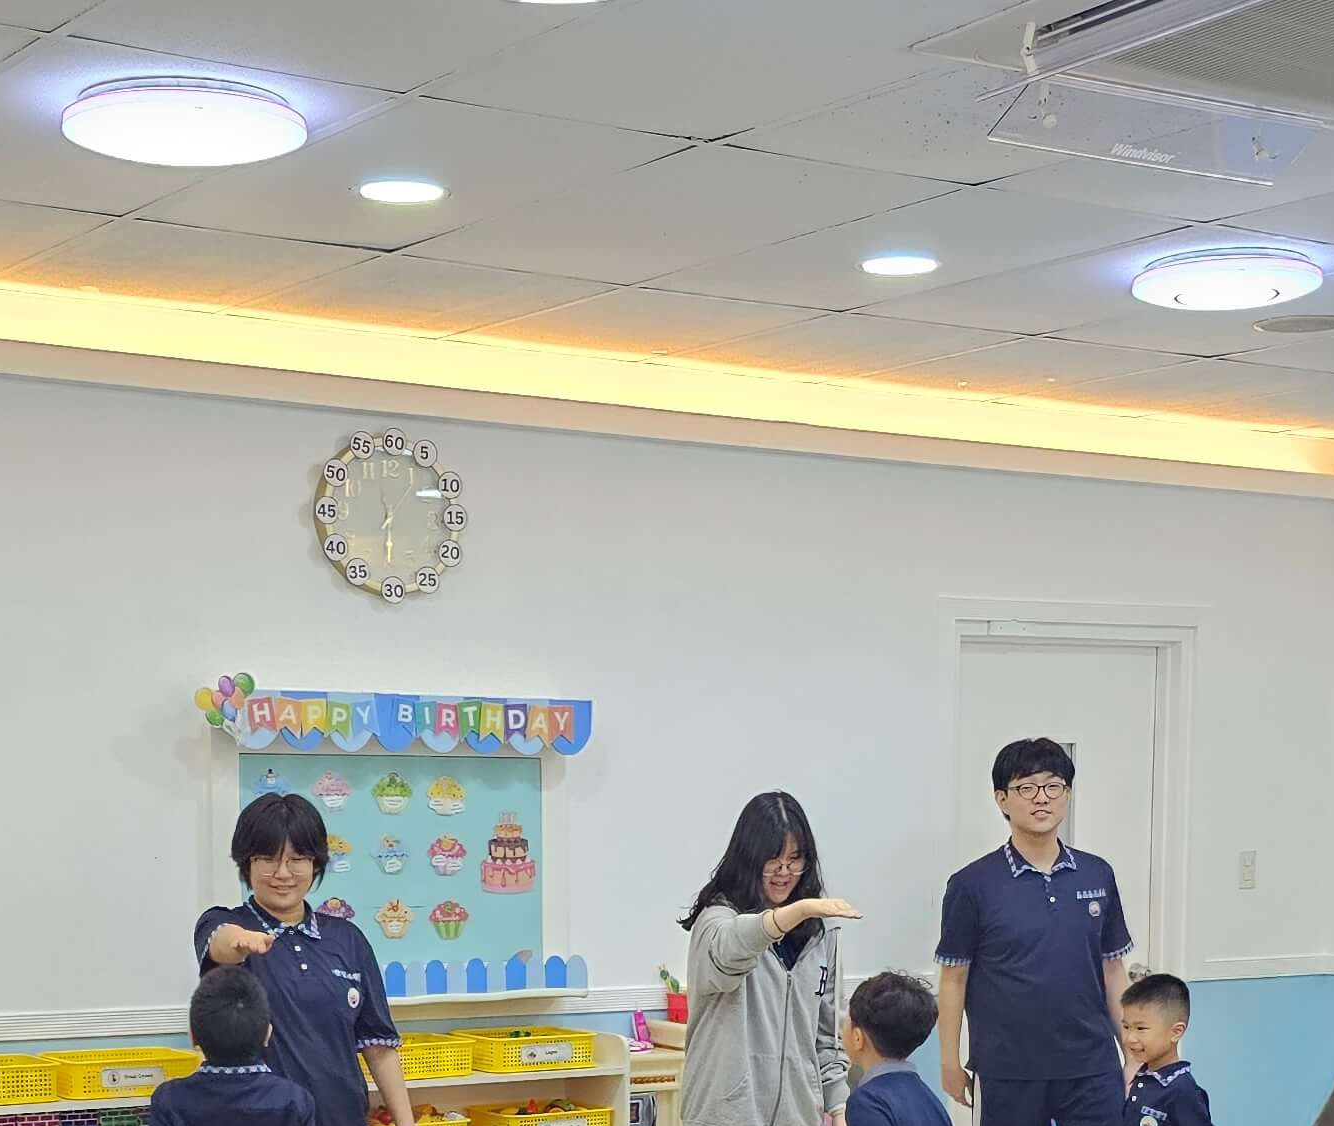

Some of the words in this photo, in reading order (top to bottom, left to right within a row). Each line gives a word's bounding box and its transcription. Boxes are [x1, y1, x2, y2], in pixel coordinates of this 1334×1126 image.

[1110, 143, 1176, 163] Windvisor
[352, 437, 371, 454] 55
[385, 434, 404, 451] 60
[420, 446, 429, 460] 5
[326, 465, 346, 481] 50
[441, 478, 460, 493] 10
[317, 503, 336, 518] 45
[446, 511, 464, 525] 15
[326, 541, 346, 555] 40
[441, 544, 460, 560] 20
[348, 565, 367, 579] 35
[418, 573, 436, 587] 25
[384, 584, 404, 598] 30
[252, 702, 371, 724] HAPPY
[397, 703, 570, 730] BIRTHDAY
